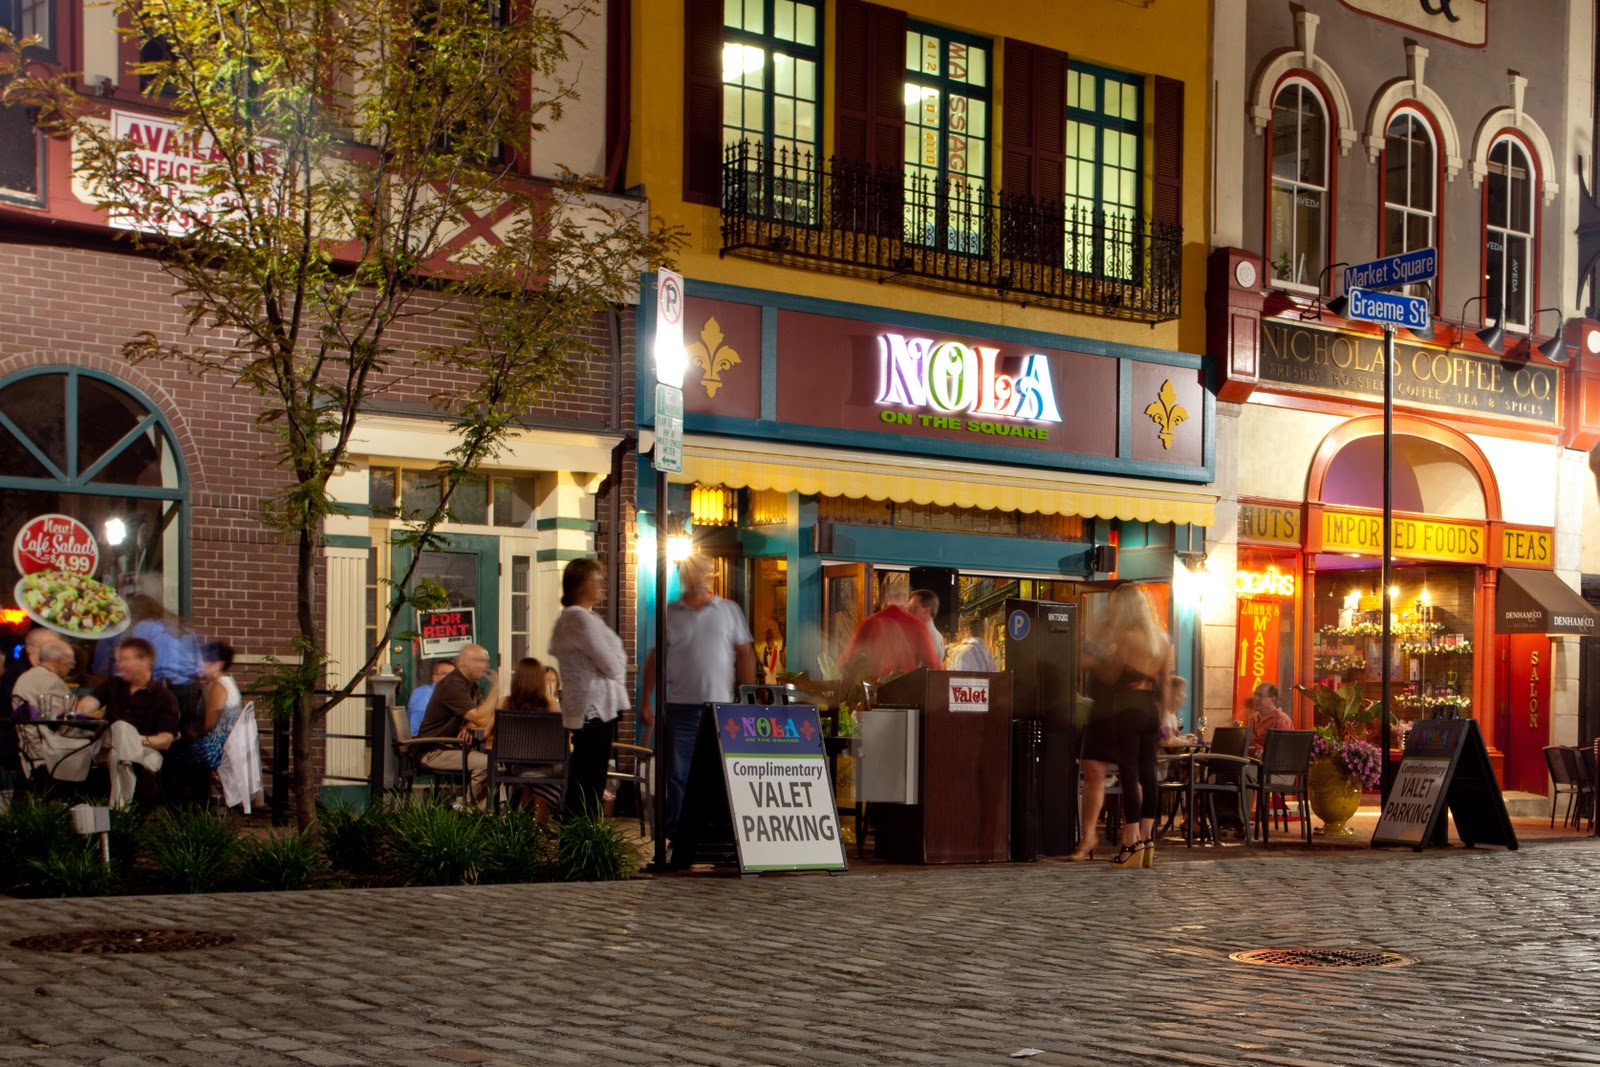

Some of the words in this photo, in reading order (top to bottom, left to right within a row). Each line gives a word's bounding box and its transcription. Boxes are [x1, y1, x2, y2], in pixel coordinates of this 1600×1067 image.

[925, 40, 937, 72] 412
[1345, 264, 1388, 290] Market
[1392, 256, 1434, 282] Square
[1511, 258, 1519, 293] AVEDA
[1351, 290, 1404, 321] Graeme
[1409, 300, 1426, 325] St
[1260, 325, 1402, 377] NICHOLAS
[1411, 350, 1505, 393] COFFEE
[1512, 368, 1551, 401] CO.
[875, 333, 1063, 423] NOLA
[1268, 362, 1321, 382] FRESHLY
[1331, 372, 1384, 391] ROASTE
[1457, 392, 1478, 406] TEA
[1488, 398, 1495, 409] &
[1505, 399, 1544, 416] SPICES
[880, 410, 913, 426] ON
[918, 414, 962, 431] THE
[965, 420, 1050, 441] SQUARE
[43, 520, 75, 535] New!
[1241, 506, 1295, 539] NUTS
[1325, 515, 1416, 551] IMPORED
[1423, 523, 1479, 555] FOODS
[19, 530, 51, 557] Café
[51, 534, 96, 556] Salads
[1505, 532, 1548, 561] TEAS
[50, 553, 91, 572] $4.99
[423, 623, 470, 639] RENT
[431, 612, 461, 625] FOR
[951, 686, 988, 703] Valet
[1529, 650, 1539, 728] SALON
[741, 717, 801, 738] NOLA
[733, 761, 823, 780] Complimentary
[1401, 762, 1447, 778] Complimentary
[748, 781, 813, 808] VALET
[1400, 777, 1436, 799] VALET
[1384, 801, 1432, 824] PARKING
[742, 814, 835, 842] PARKING
